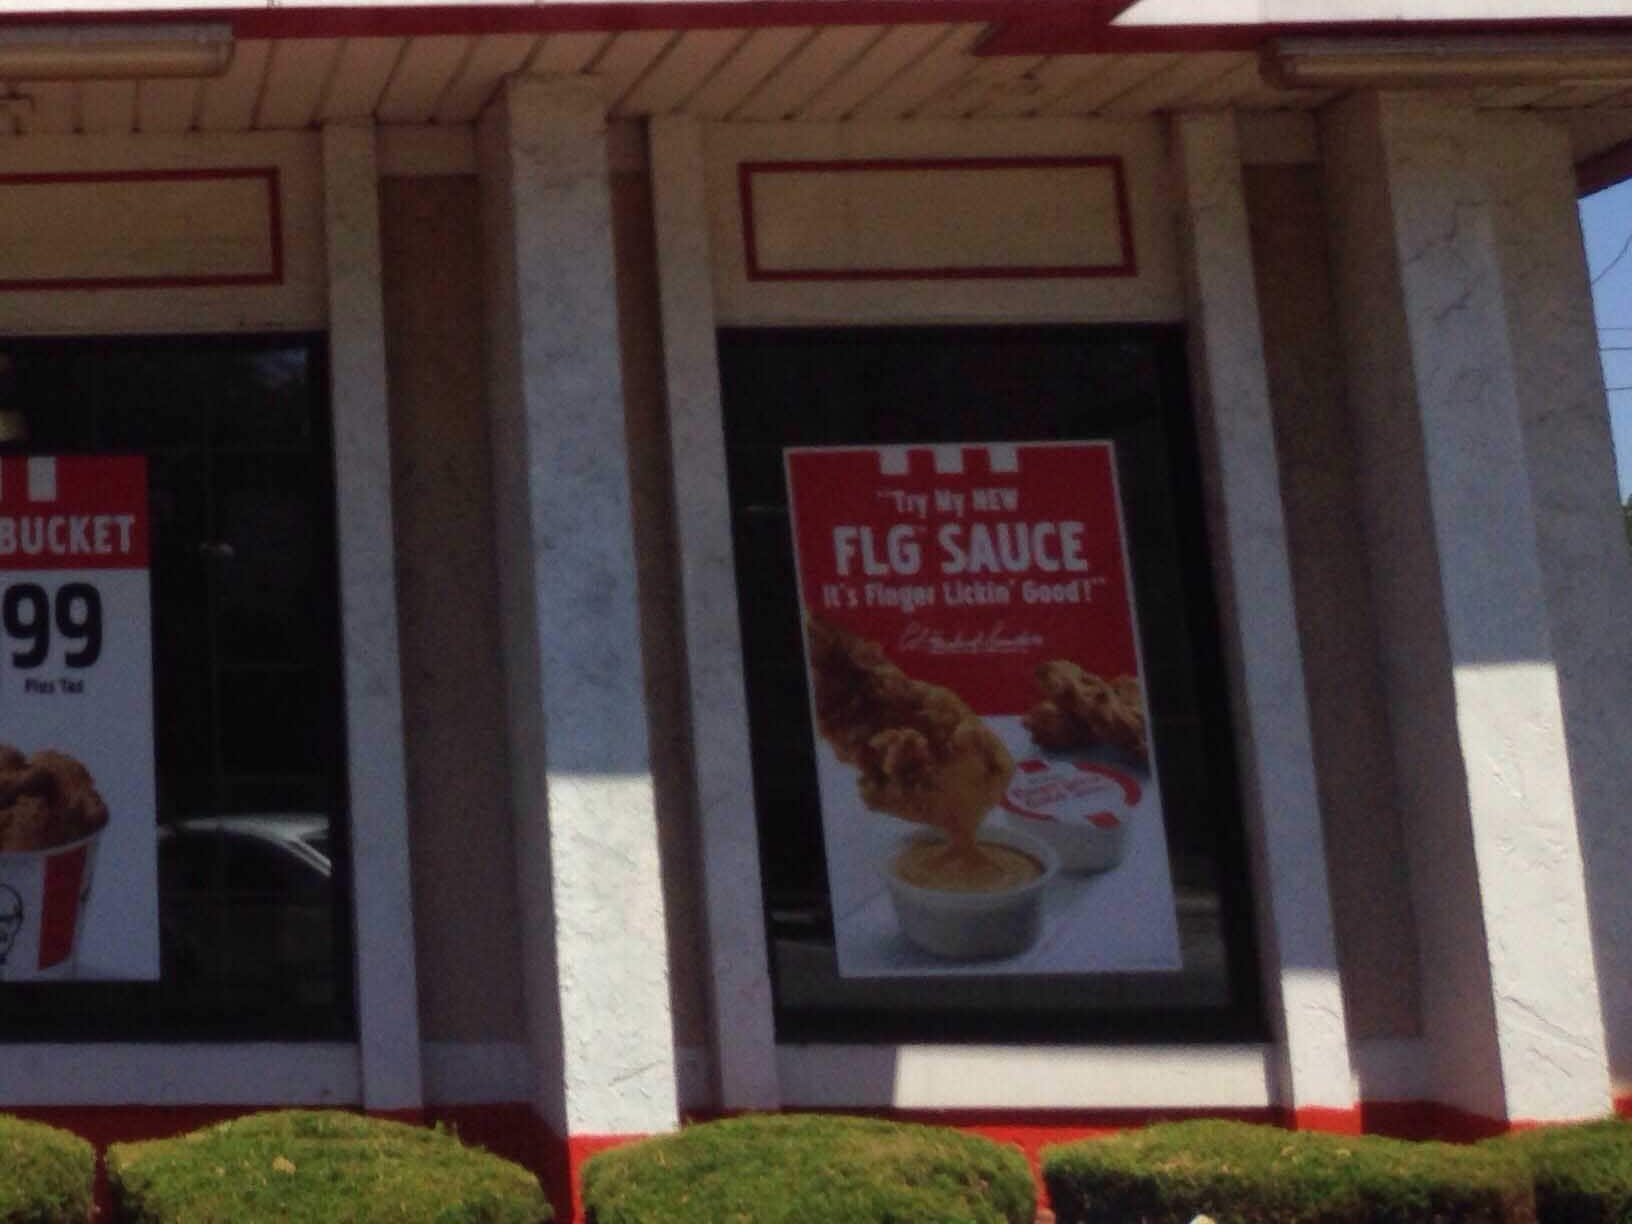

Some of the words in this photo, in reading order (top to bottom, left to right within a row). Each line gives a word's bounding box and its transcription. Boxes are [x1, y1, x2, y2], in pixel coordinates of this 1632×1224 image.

[934, 488, 965, 518] My
[971, 488, 1018, 512] NEW
[937, 519, 1089, 575] SAUCE
[822, 582, 858, 609] It's
[864, 580, 935, 614] Finger
